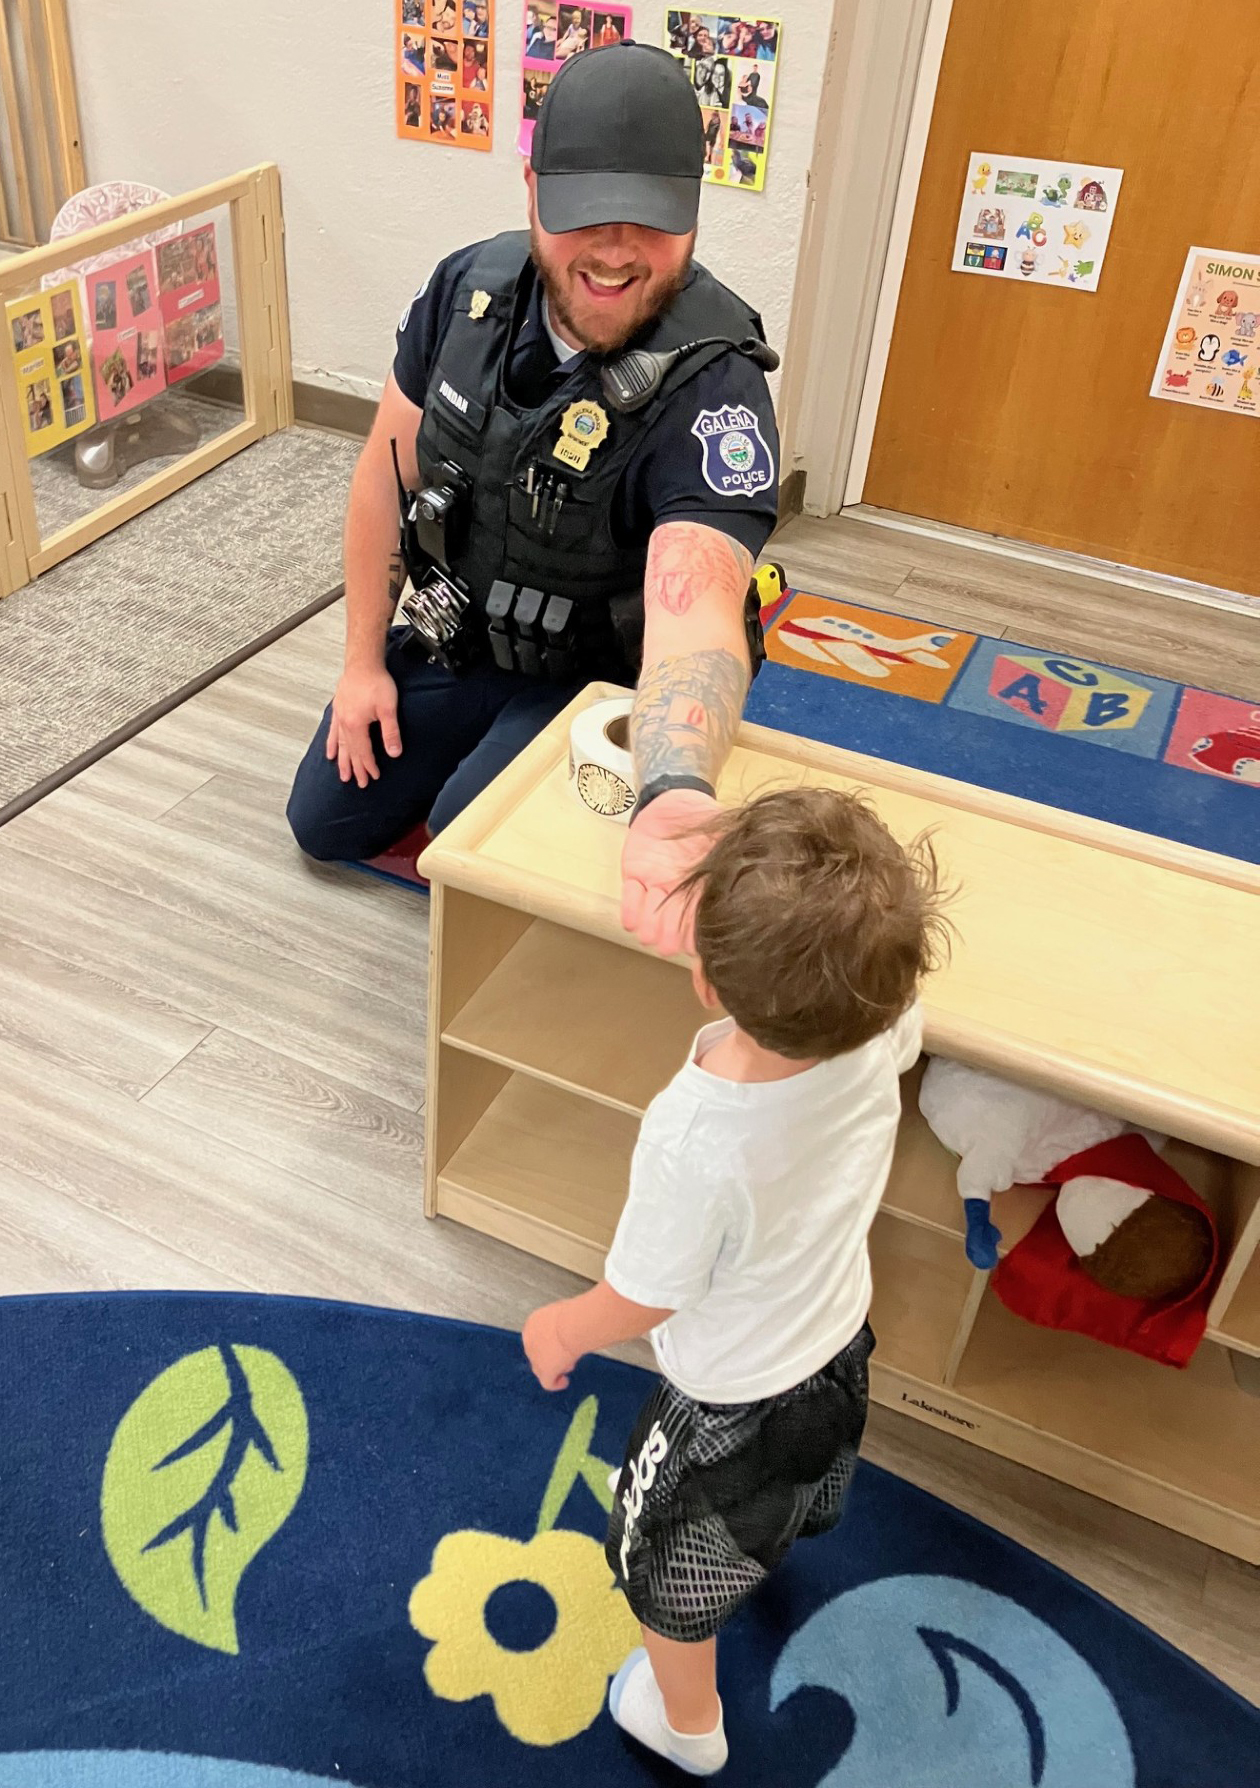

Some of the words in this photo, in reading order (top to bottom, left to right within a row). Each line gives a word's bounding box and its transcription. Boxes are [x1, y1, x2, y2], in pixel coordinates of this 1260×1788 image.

[1205, 262, 1255, 281] SIMON
[700, 412, 753, 435] GALENA
[721, 470, 766, 488] POLICE
[1043, 660, 1099, 686] C
[998, 673, 1048, 715] A
[1082, 692, 1129, 726] B
[901, 1392, 976, 1430] Lakeshore
